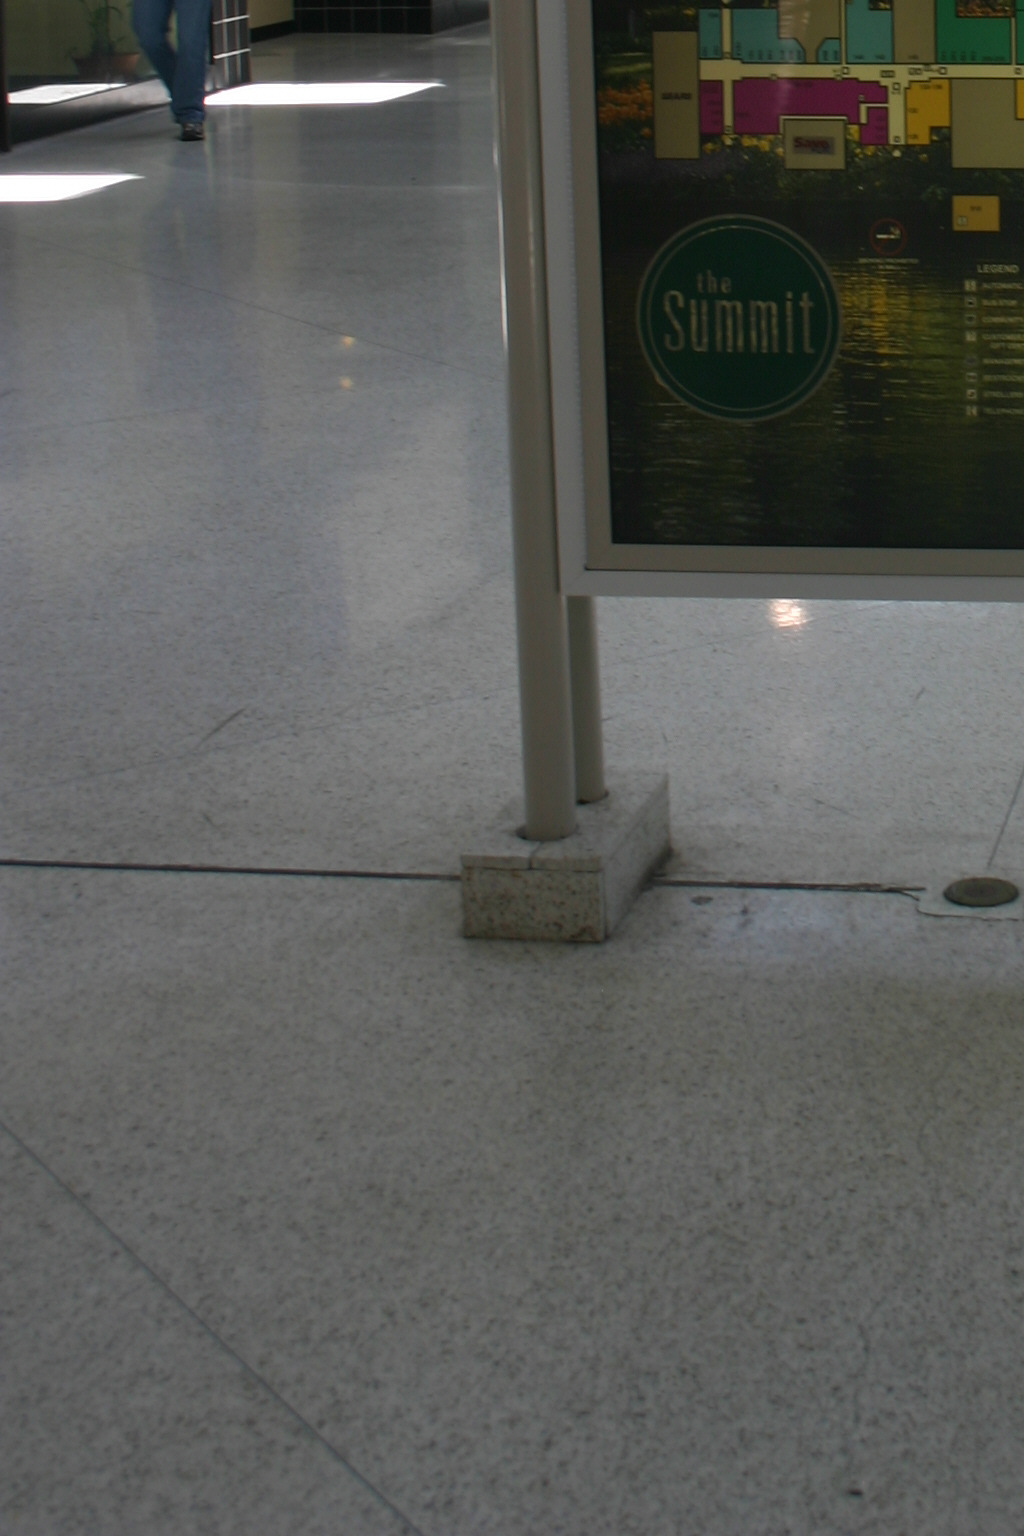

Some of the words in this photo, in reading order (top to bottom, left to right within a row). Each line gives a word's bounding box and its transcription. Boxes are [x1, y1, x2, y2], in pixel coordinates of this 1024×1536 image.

[976, 263, 1020, 274] LEGEND
[696, 269, 732, 294] the
[663, 291, 816, 354] Summit
